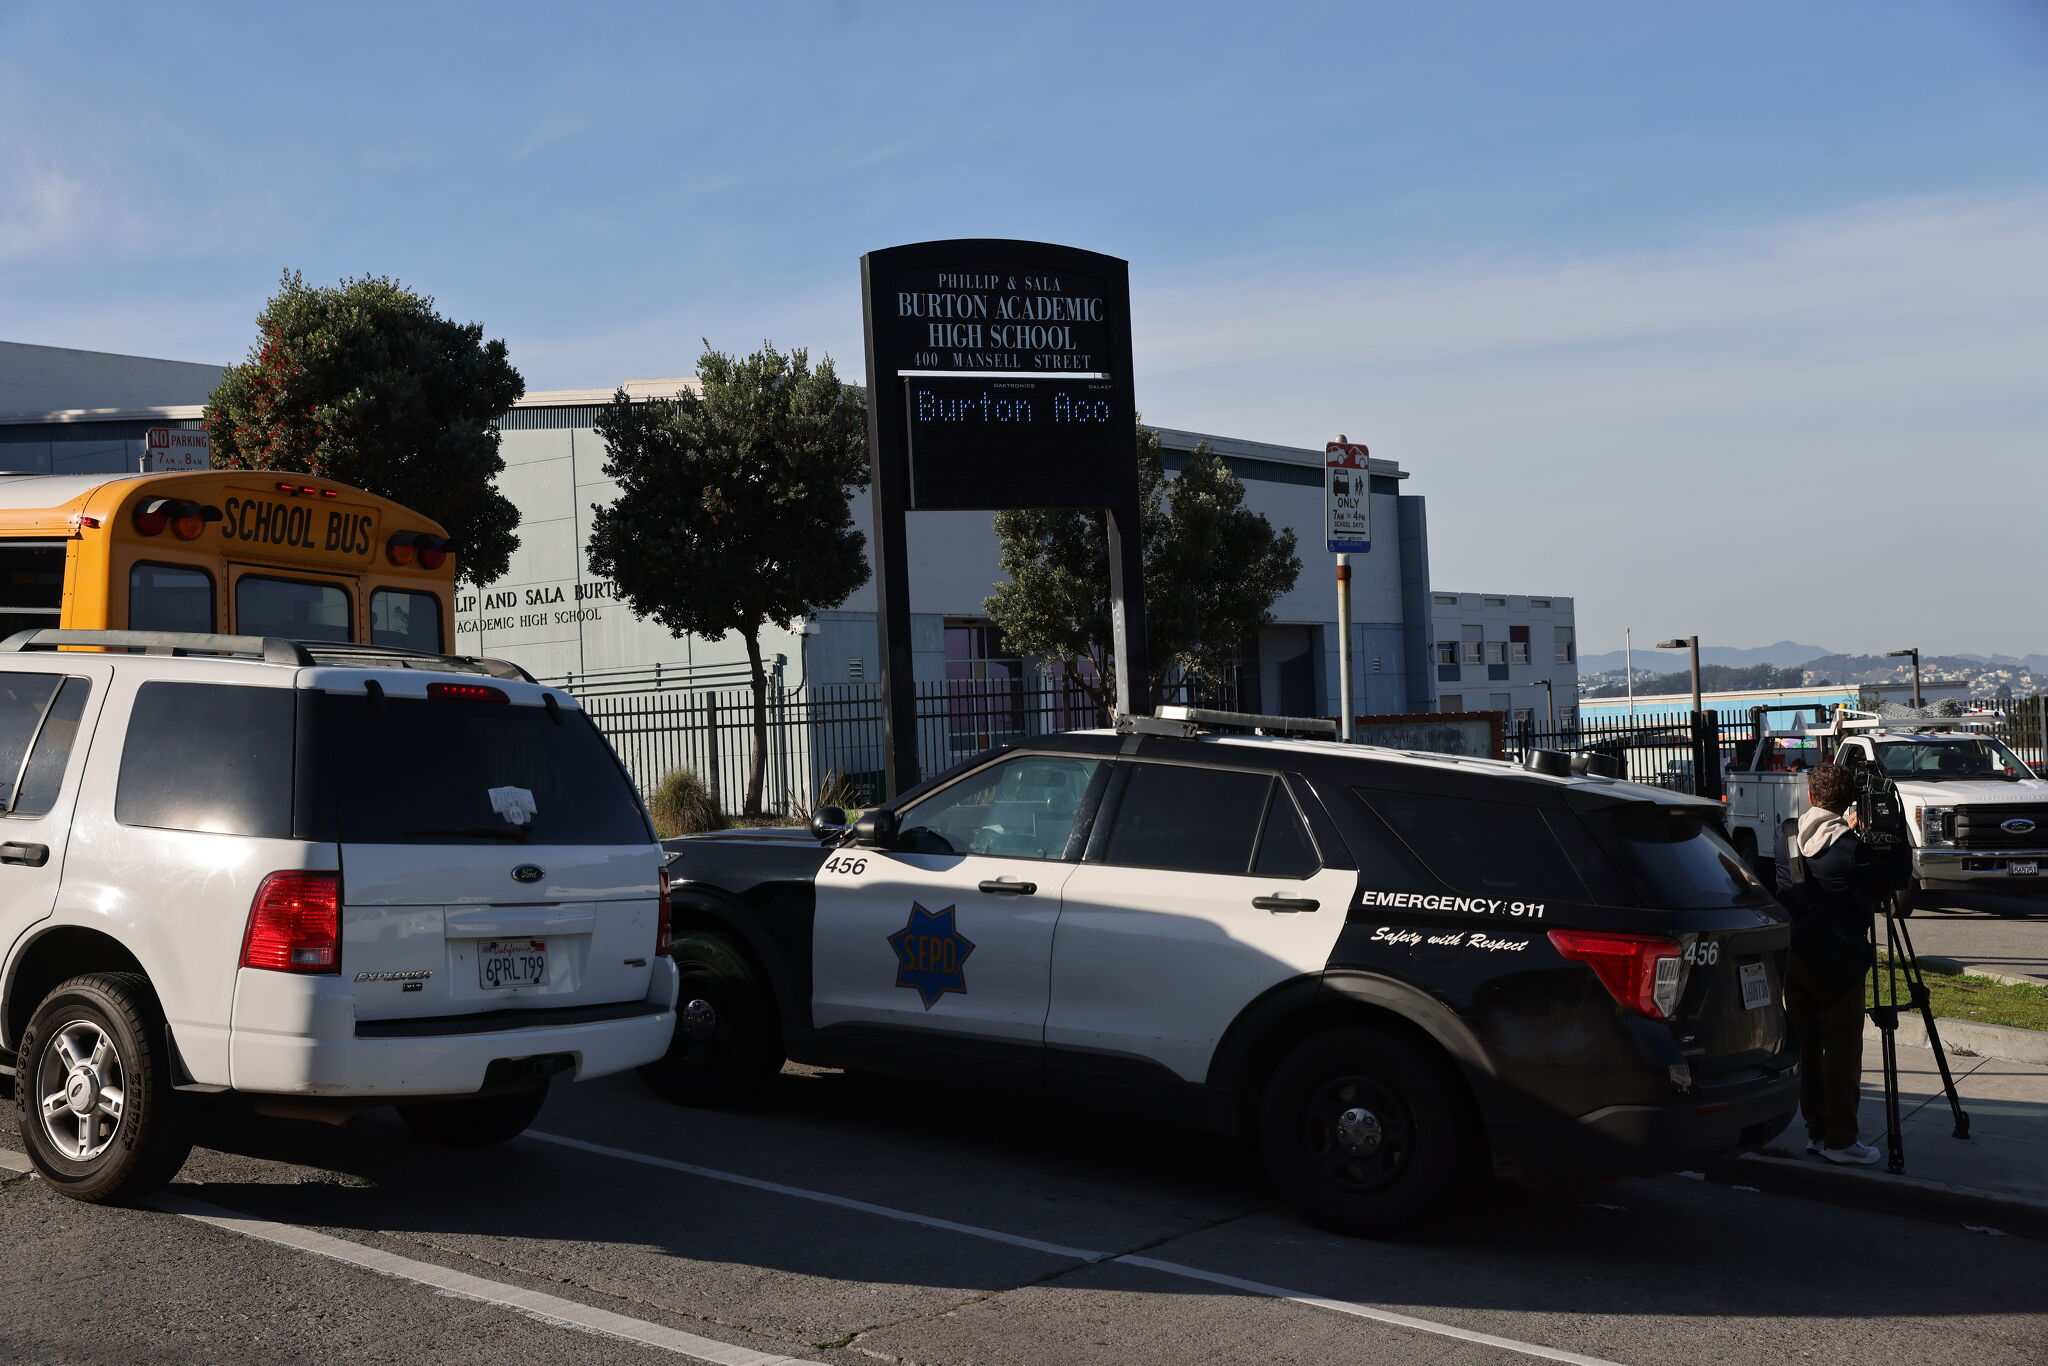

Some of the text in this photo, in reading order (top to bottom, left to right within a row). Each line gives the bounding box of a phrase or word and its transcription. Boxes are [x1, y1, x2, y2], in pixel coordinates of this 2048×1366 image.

[938, 273, 1062, 291] PHILLIP & SALA
[897, 292, 1104, 322] BURTON ACADEMIC
[928, 323, 1077, 350] HIGH SCHOOL
[913, 352, 1091, 369] 400 MANSELL STREET
[919, 391, 1032, 422] Burton
[151, 430, 207, 448] NO PARKING
[1337, 497, 1360, 508] ONLY
[221, 497, 373, 555] SCHOOL BUS
[484, 592, 517, 610] AND
[525, 587, 565, 606] SALA
[457, 608, 601, 633] ACADEMIC HIGH SCHOOL
[825, 857, 868, 875] 456
[1362, 890, 1502, 914] EMERGENCY
[1510, 901, 1545, 918] 911
[493, 943, 531, 957] California
[1370, 927, 1529, 952] Safety with Respect
[1684, 941, 1719, 966] 456
[486, 956, 544, 982] 6PRL799
